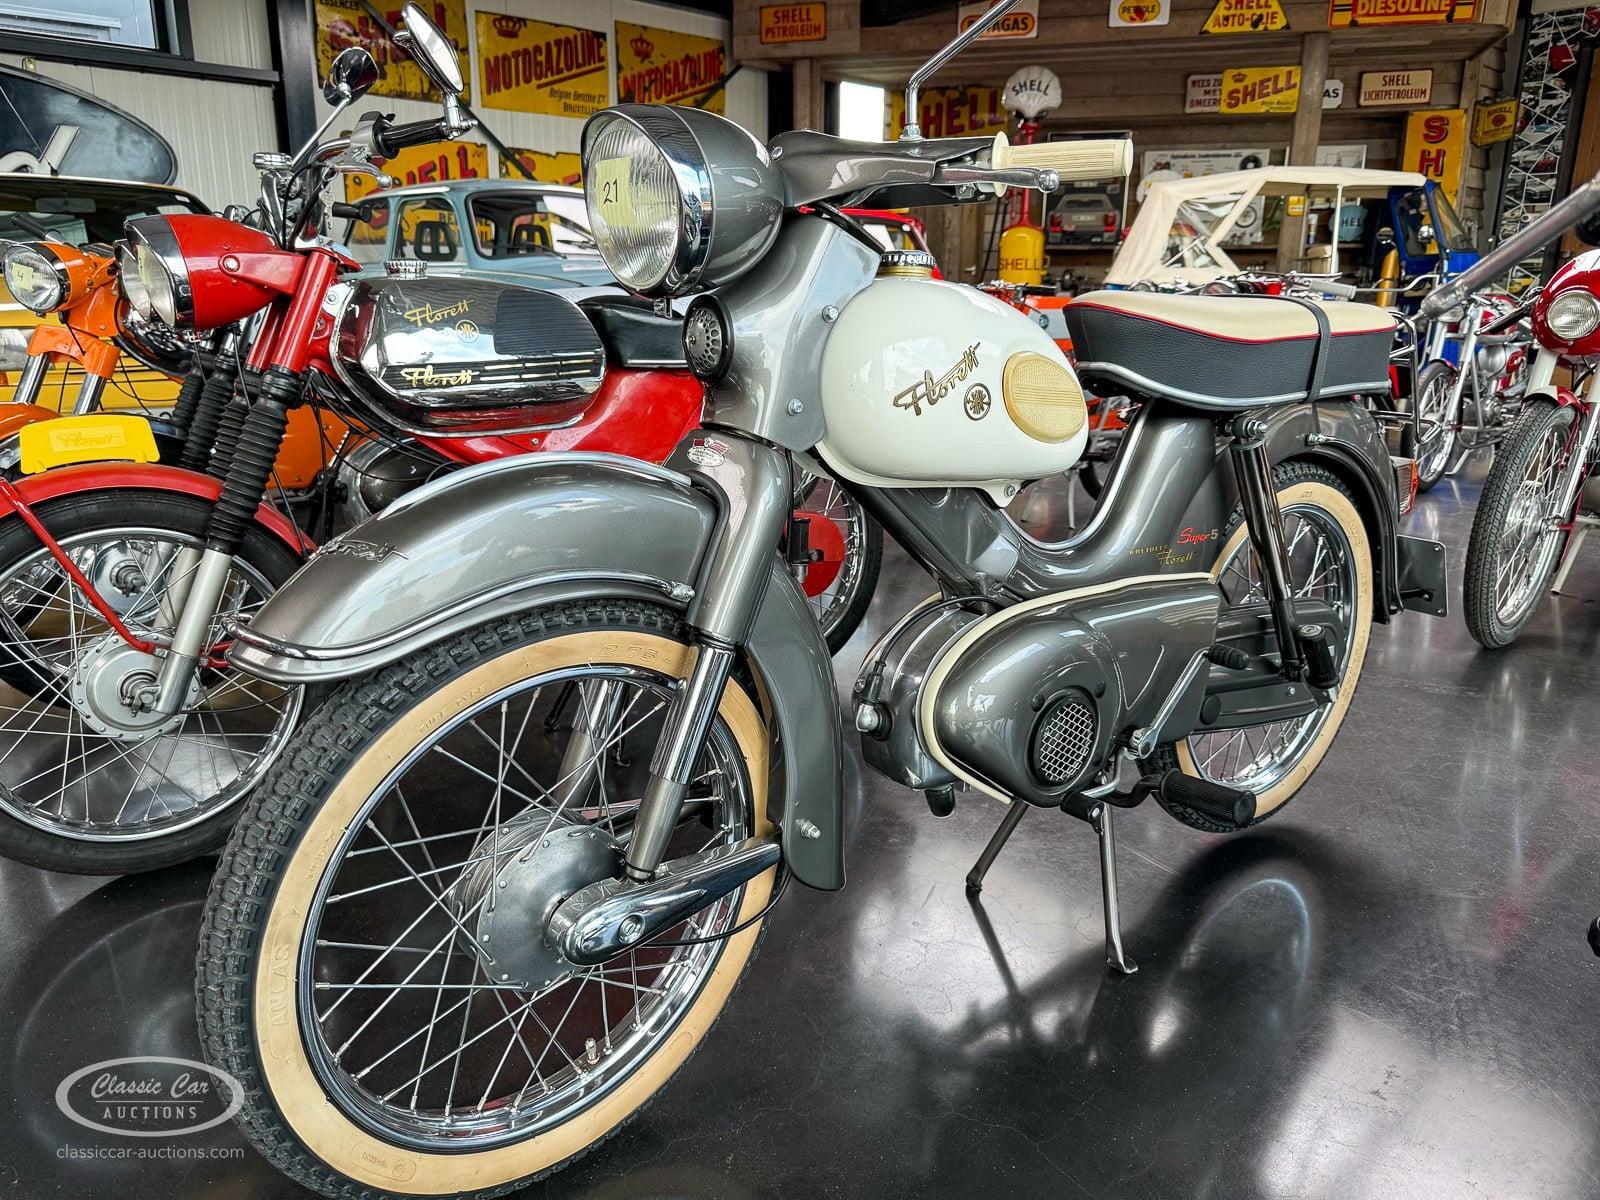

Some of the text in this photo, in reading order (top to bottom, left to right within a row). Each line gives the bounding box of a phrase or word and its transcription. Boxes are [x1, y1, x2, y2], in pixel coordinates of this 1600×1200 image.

[1122, 5, 1157, 14] PEOLE
[1357, 0, 1450, 14] DIESOLINE
[773, 8, 812, 24] SHELL
[1213, 11, 1278, 28] AUTO-OIE
[329, 2, 459, 65] SHEL
[765, 24, 821, 40] PETROLEUM
[484, 31, 605, 95] MOTOGAZOLINE
[1012, 80, 1049, 96] SHELL
[1382, 74, 1411, 87] SHELL
[1227, 70, 1298, 109] SHELL
[1364, 88, 1428, 101] LICHTPETROLEUM
[900, 89, 1004, 139] HELL
[603, 178, 618, 204] 21
[999, 258, 1040, 271] SHELL
[404, 299, 475, 328] Florett
[400, 364, 481, 388] Florett
[893, 341, 981, 416] Florett
